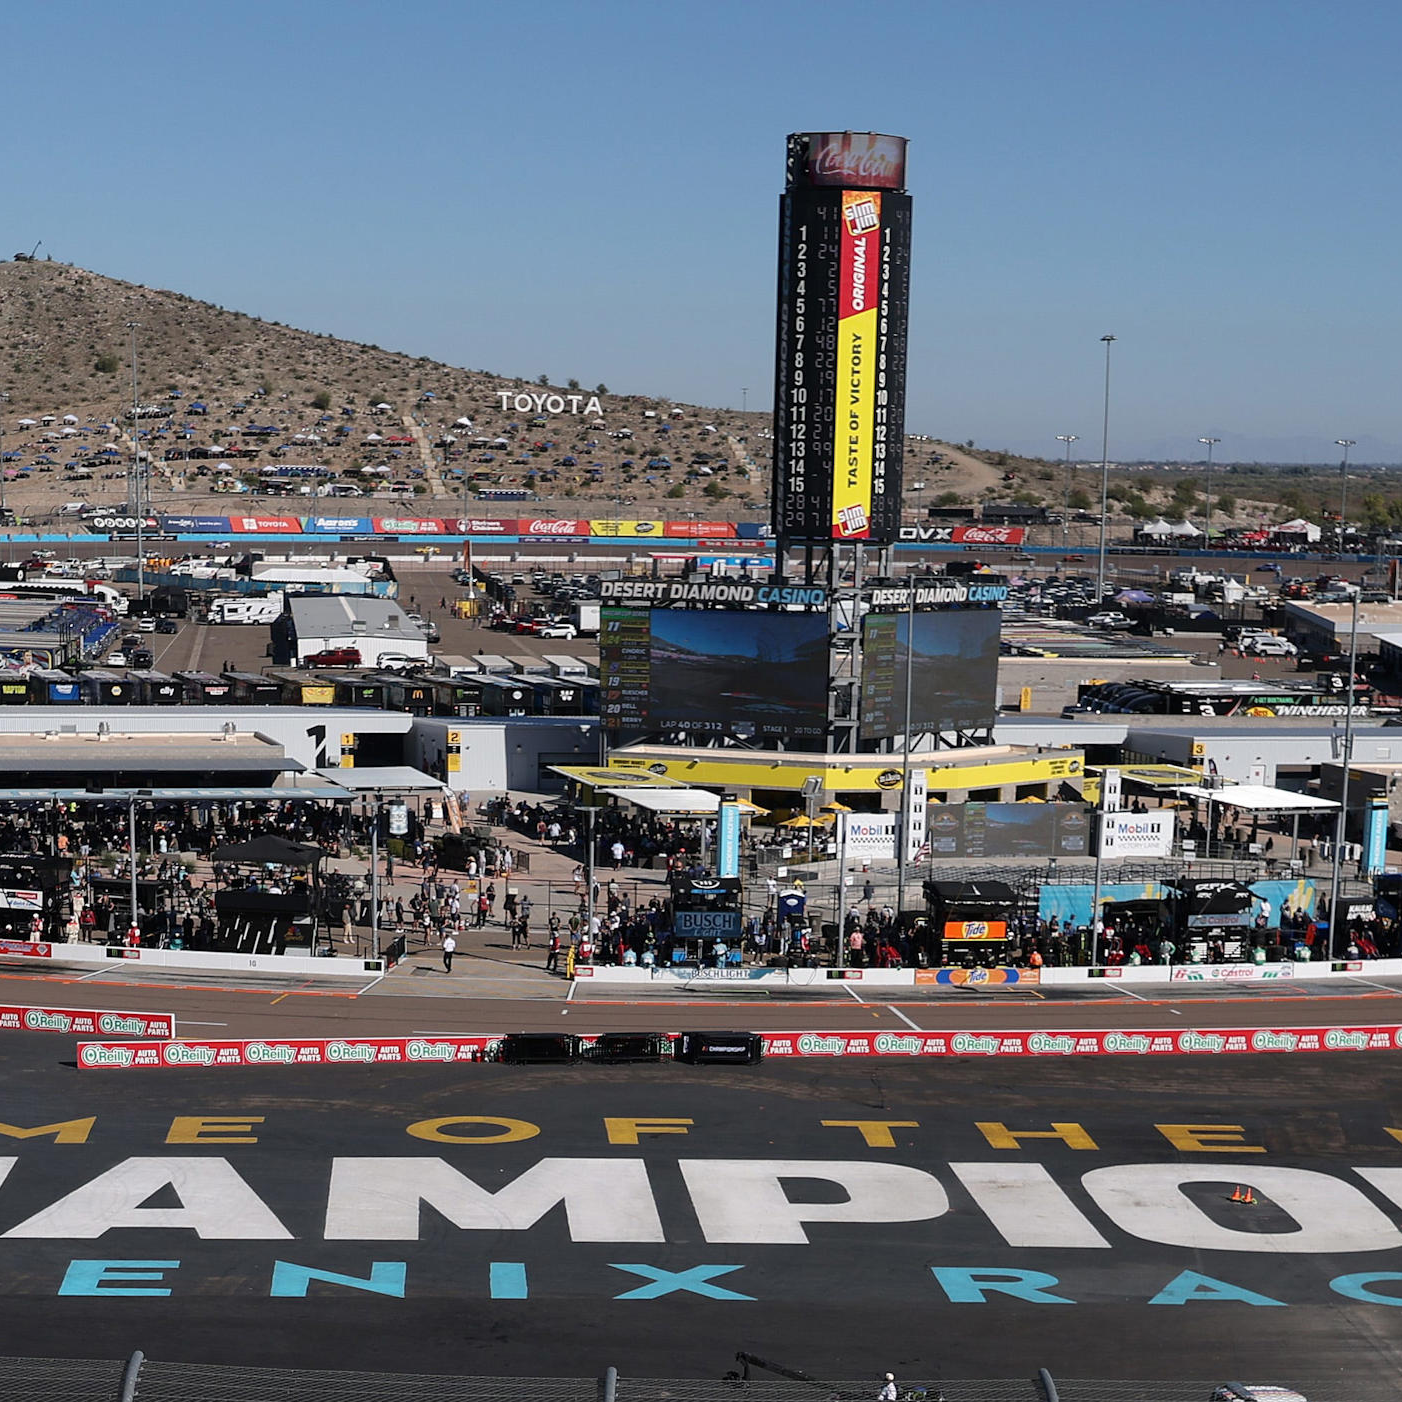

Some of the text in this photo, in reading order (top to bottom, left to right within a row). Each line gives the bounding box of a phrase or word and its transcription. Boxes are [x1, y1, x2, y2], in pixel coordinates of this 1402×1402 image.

[799, 226, 806, 240] 1
[798, 245, 806, 259] 2
[797, 263, 806, 277] 3
[852, 236, 866, 310] ORIGINAL
[796, 281, 805, 295] 4
[796, 300, 805, 314] 5
[796, 318, 804, 332] 6
[796, 335, 804, 349] 7
[795, 354, 804, 368] 8
[794, 371, 803, 385] 9
[791, 388, 807, 403] 10
[497, 391, 603, 416] TOYOTA
[848, 333, 862, 488] TASTE OF VICTORY
[790, 406, 806, 421] 11
[790, 424, 806, 439] 12
[790, 442, 805, 457] 13
[789, 460, 805, 475] 14
[788, 477, 804, 492] 15
[317, 517, 358, 528] Aaron's
[600, 581, 825, 604] DESERT DIAMOND CASINO
[872, 586, 1008, 605] DESERT DIAMOND CASINO
[1332, 676, 1344, 688] 3
[159, 686, 175, 697] ally
[607, 704, 620, 714] 20
[1277, 705, 1368, 717] WINCHESTER
[678, 721, 690, 729] 40
[704, 722, 723, 730] 312
[763, 725, 781, 733] STAGE
[450, 733, 459, 742] 2
[1195, 745, 1203, 754] 3
[850, 825, 883, 836] Mobil
[1118, 823, 1149, 834] Mobil
[1349, 904, 1373, 912] KAULIG
[683, 913, 733, 929] BUSCH
[1207, 916, 1239, 925] Castrol
[965, 925, 987, 936] Tide
[968, 969, 989, 982] Tide
[1221, 968, 1254, 979] Castrol
[951, 1033, 1000, 1054] O'Reilly
[1000, 1044, 1023, 1052] PARTS
[81, 1043, 135, 1066] O'Reilly
[135, 1056, 159, 1065] PARTS
[138, 1050, 156, 1058] AUTO
[407, 1116, 693, 1145] OF
[821, 1120, 1266, 1153] THE
